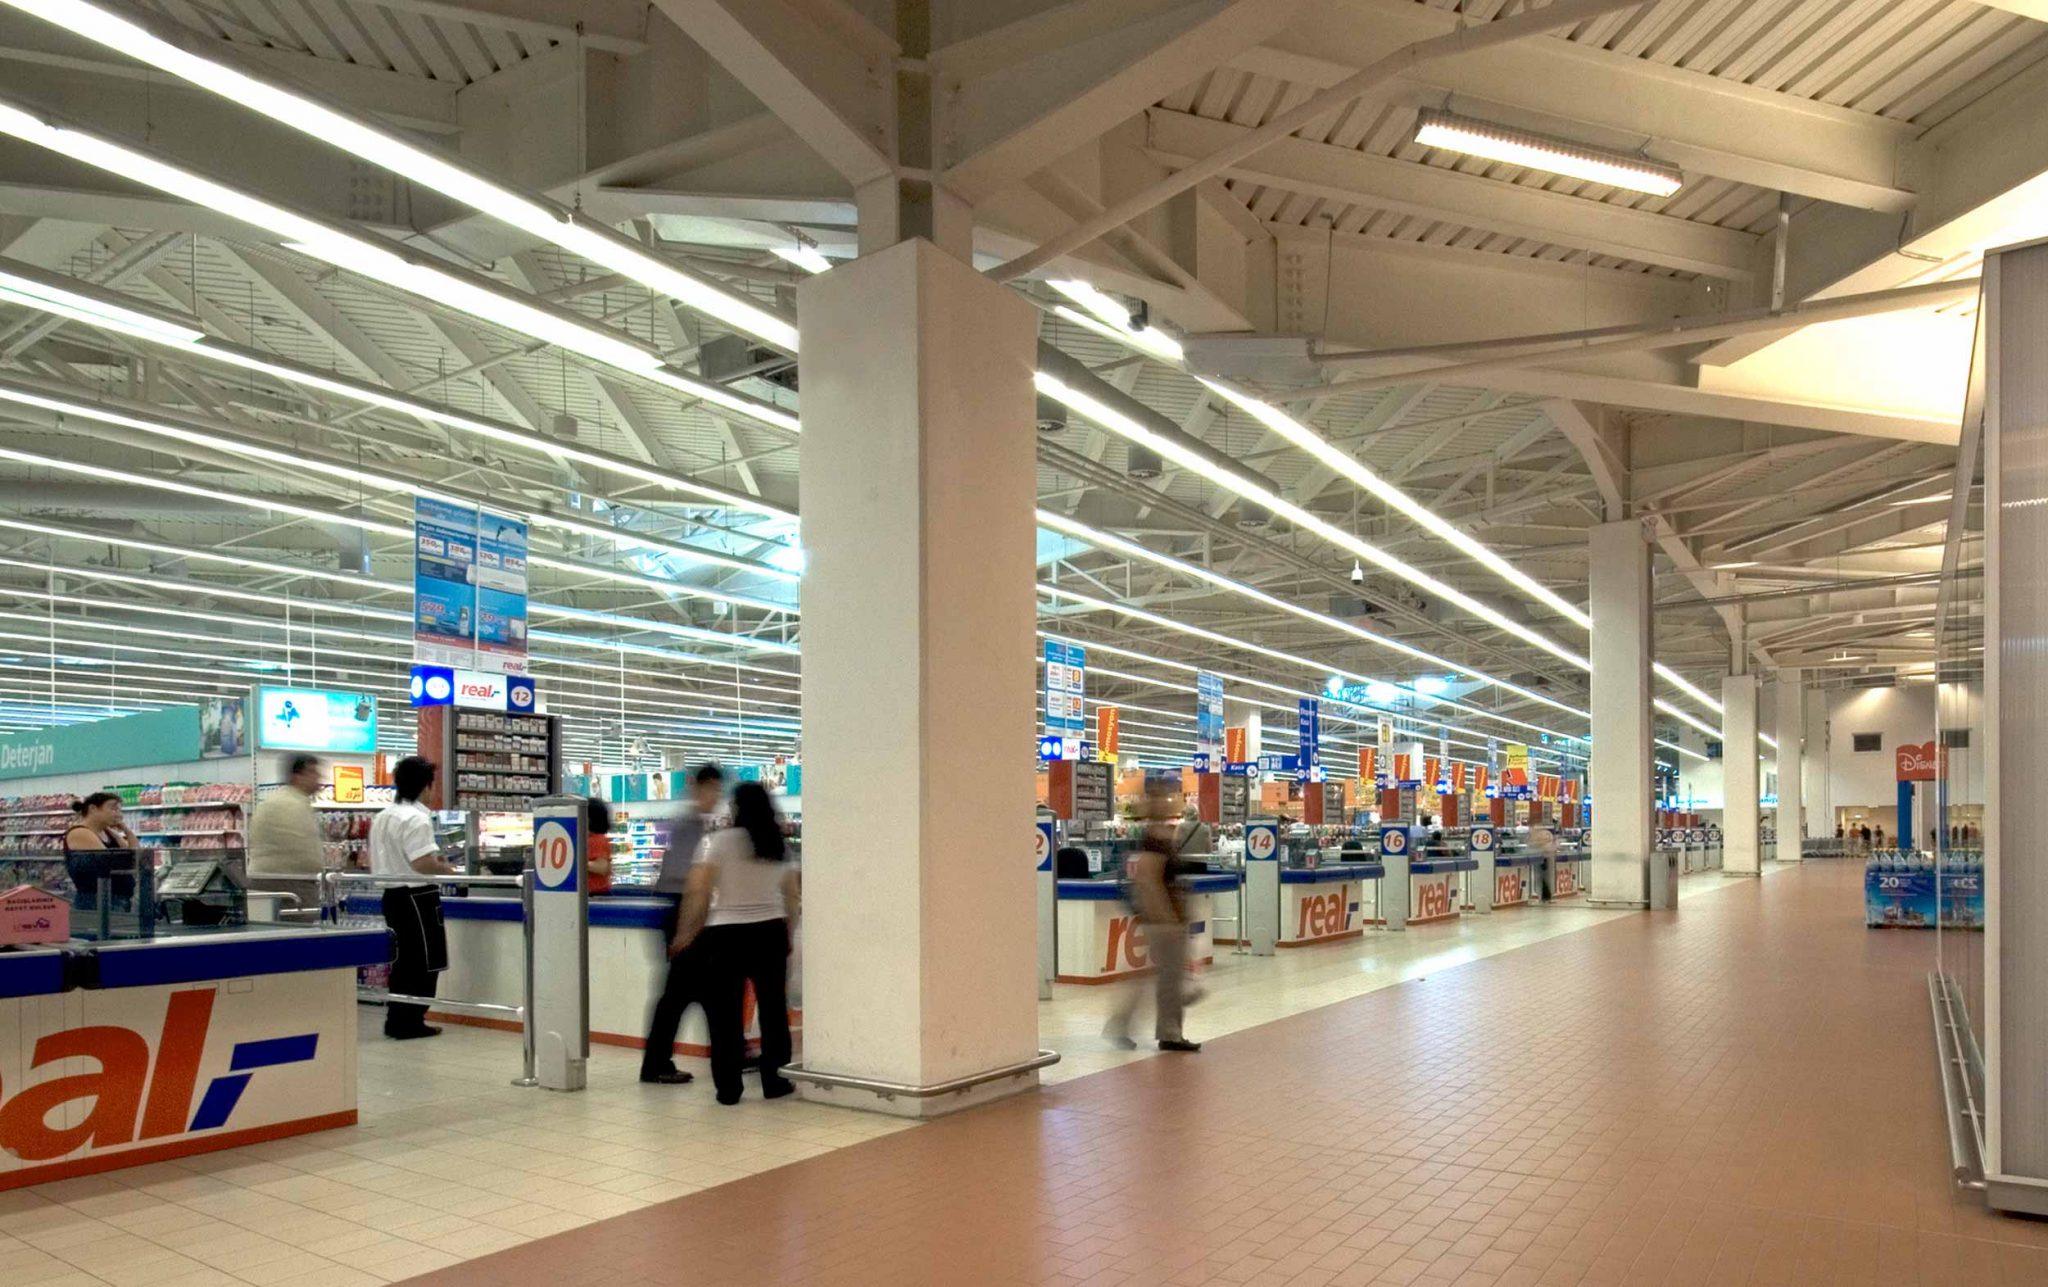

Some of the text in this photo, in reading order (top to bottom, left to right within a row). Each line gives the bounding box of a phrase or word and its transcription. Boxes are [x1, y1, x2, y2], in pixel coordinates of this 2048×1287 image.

[514, 691, 530, 702] 12
[1, 738, 54, 773] Deterjan
[1897, 752, 1938, 772] Disne
[1250, 834, 1272, 851] 14
[1384, 834, 1404, 849] 16
[1473, 832, 1490, 845] 18
[1583, 832, 1592, 842] 2
[538, 836, 568, 870] 10
